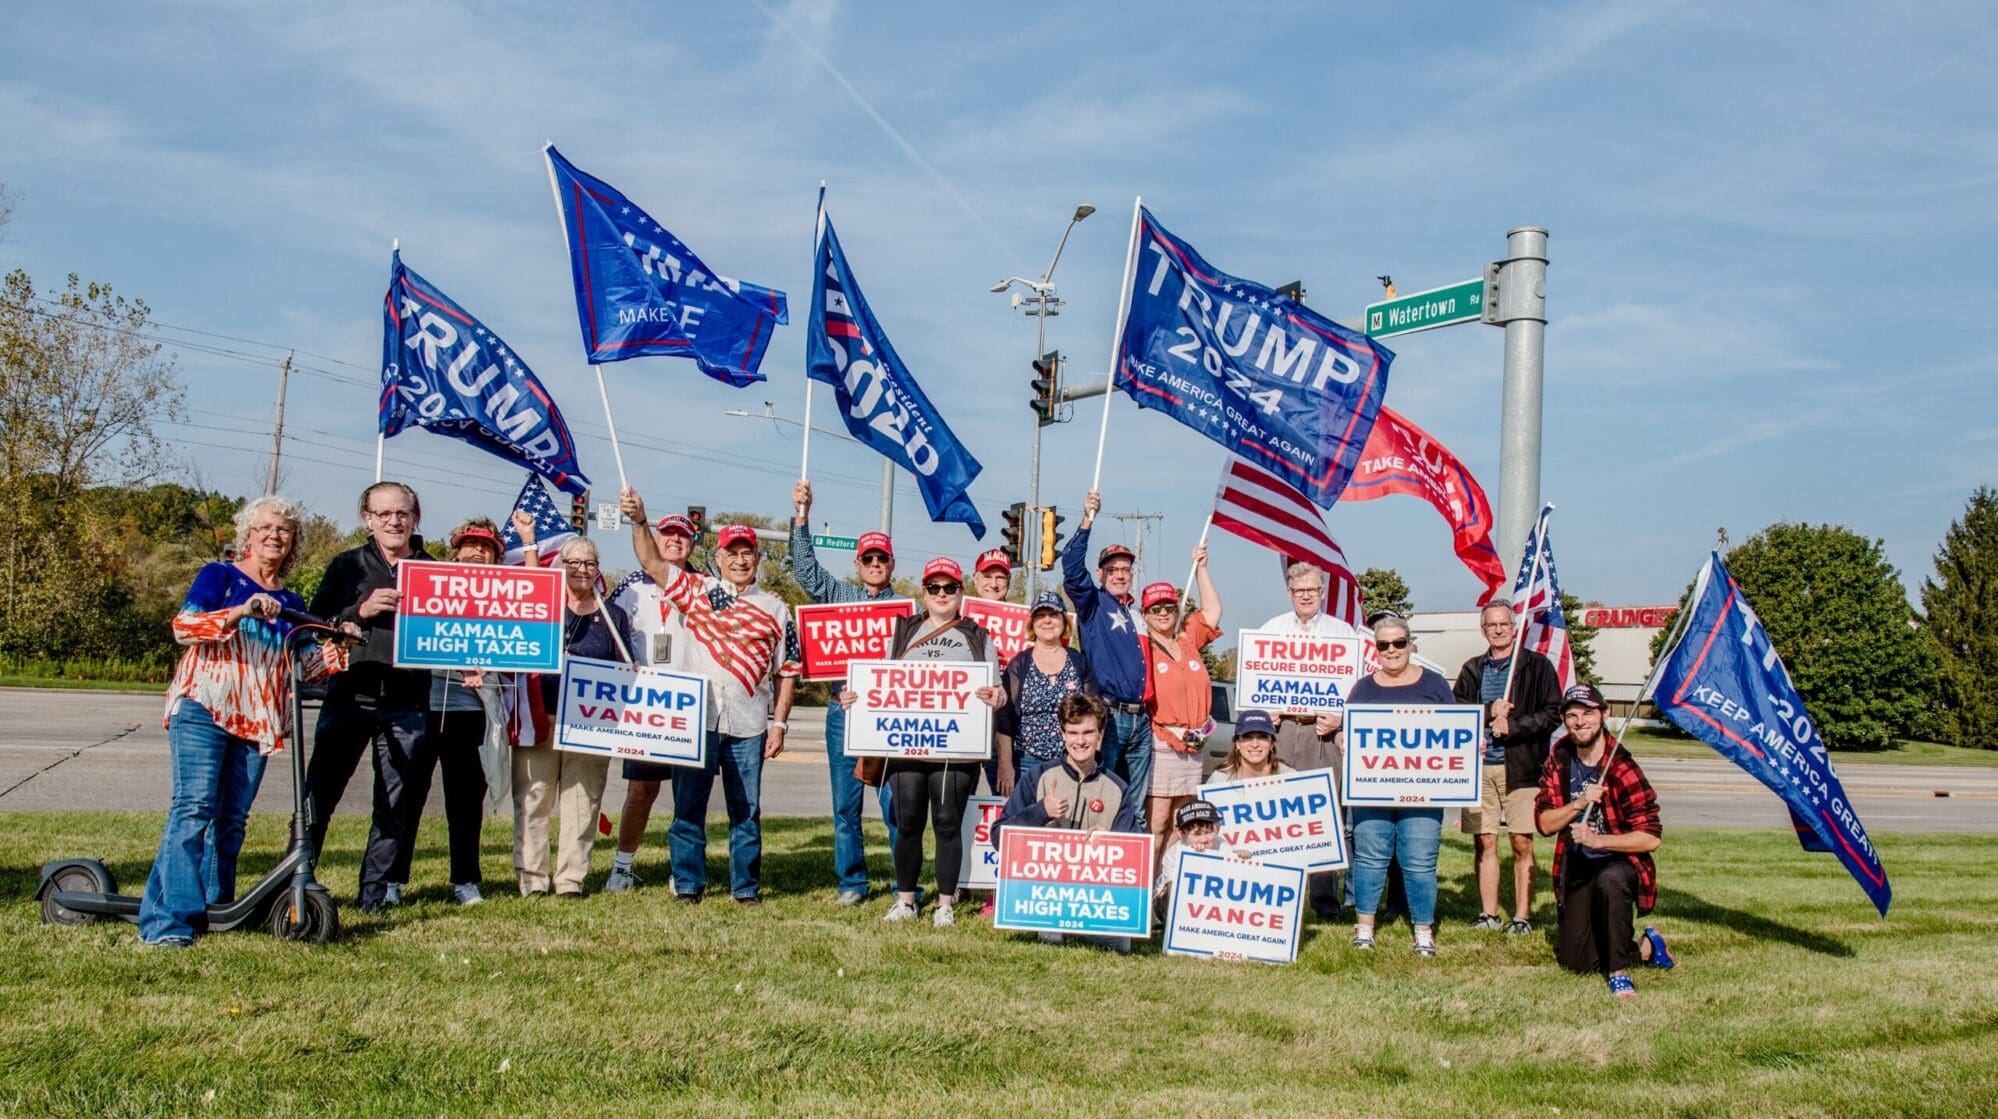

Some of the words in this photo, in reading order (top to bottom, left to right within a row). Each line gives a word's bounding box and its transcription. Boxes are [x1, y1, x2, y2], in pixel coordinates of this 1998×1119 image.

[619, 307, 669, 324] MAKE
[1148, 240, 1360, 390] TRUMP
[1389, 298, 1456, 327] Watertown
[1469, 294, 1480, 305] Rd
[1168, 326, 1283, 416] 2024
[1157, 371, 1223, 410] AMERICA
[1226, 406, 1267, 439] GREAT
[1269, 436, 1315, 466] AGAIN
[1362, 456, 1404, 474] TAKE
[429, 575, 535, 600] TRUMP
[413, 597, 467, 615] LOW
[474, 600, 548, 619] TAXES
[435, 621, 524, 640] KAMALA
[970, 613, 1024, 637] TRU
[417, 637, 468, 653] HIGH
[475, 640, 541, 656] TAXES
[917, 637, 963, 648] UMP
[993, 636, 1034, 652] ANC
[1254, 640, 1346, 662] TRUMP
[465, 657, 492, 665] 2024
[1245, 660, 1296, 672] SECURE
[1300, 664, 1354, 675] BORDER
[871, 669, 969, 689] TRUMP
[1258, 679, 1339, 696] KAMALA
[572, 678, 696, 710] TRUMP
[867, 690, 971, 710] SAFETY
[1251, 694, 1287, 705] OPEN
[1290, 696, 1344, 708] BORDER
[578, 704, 687, 730] VANCE
[876, 717, 960, 733] KAMALA
[596, 727, 633, 737] AMERICA
[636, 732, 662, 740] GREAT
[664, 735, 692, 744] AGAIN!
[887, 733, 948, 748] CRIME
[1354, 728, 1473, 749] TRUMP
[1693, 684, 1750, 721] KEEP
[1750, 722, 1828, 800] AMERICA
[617, 747, 645, 756] 2024
[1361, 756, 1464, 770] VANCE
[1216, 794, 1327, 826] TRUMP
[1224, 821, 1324, 846] VANCE
[1027, 841, 1124, 865] TRUMP
[1252, 848, 1278, 857] ERICA
[1280, 845, 1304, 853] GREAT
[1306, 841, 1332, 850] AGAIN!
[1011, 862, 1061, 879] LOW
[1068, 865, 1137, 884] TAXES
[1031, 886, 1115, 904] KAMALA
[1184, 872, 1295, 907] TRUMP
[1015, 900, 1062, 916] HIGH
[1068, 903, 1129, 920] TAXES
[1187, 903, 1284, 929] VANCE
[1058, 920, 1084, 928] 2024
[1179, 925, 1200, 934] MAKE
[1201, 928, 1235, 938] AMERICA
[1236, 933, 1260, 942] GREAT
[1261, 936, 1287, 945] AGAIN!
